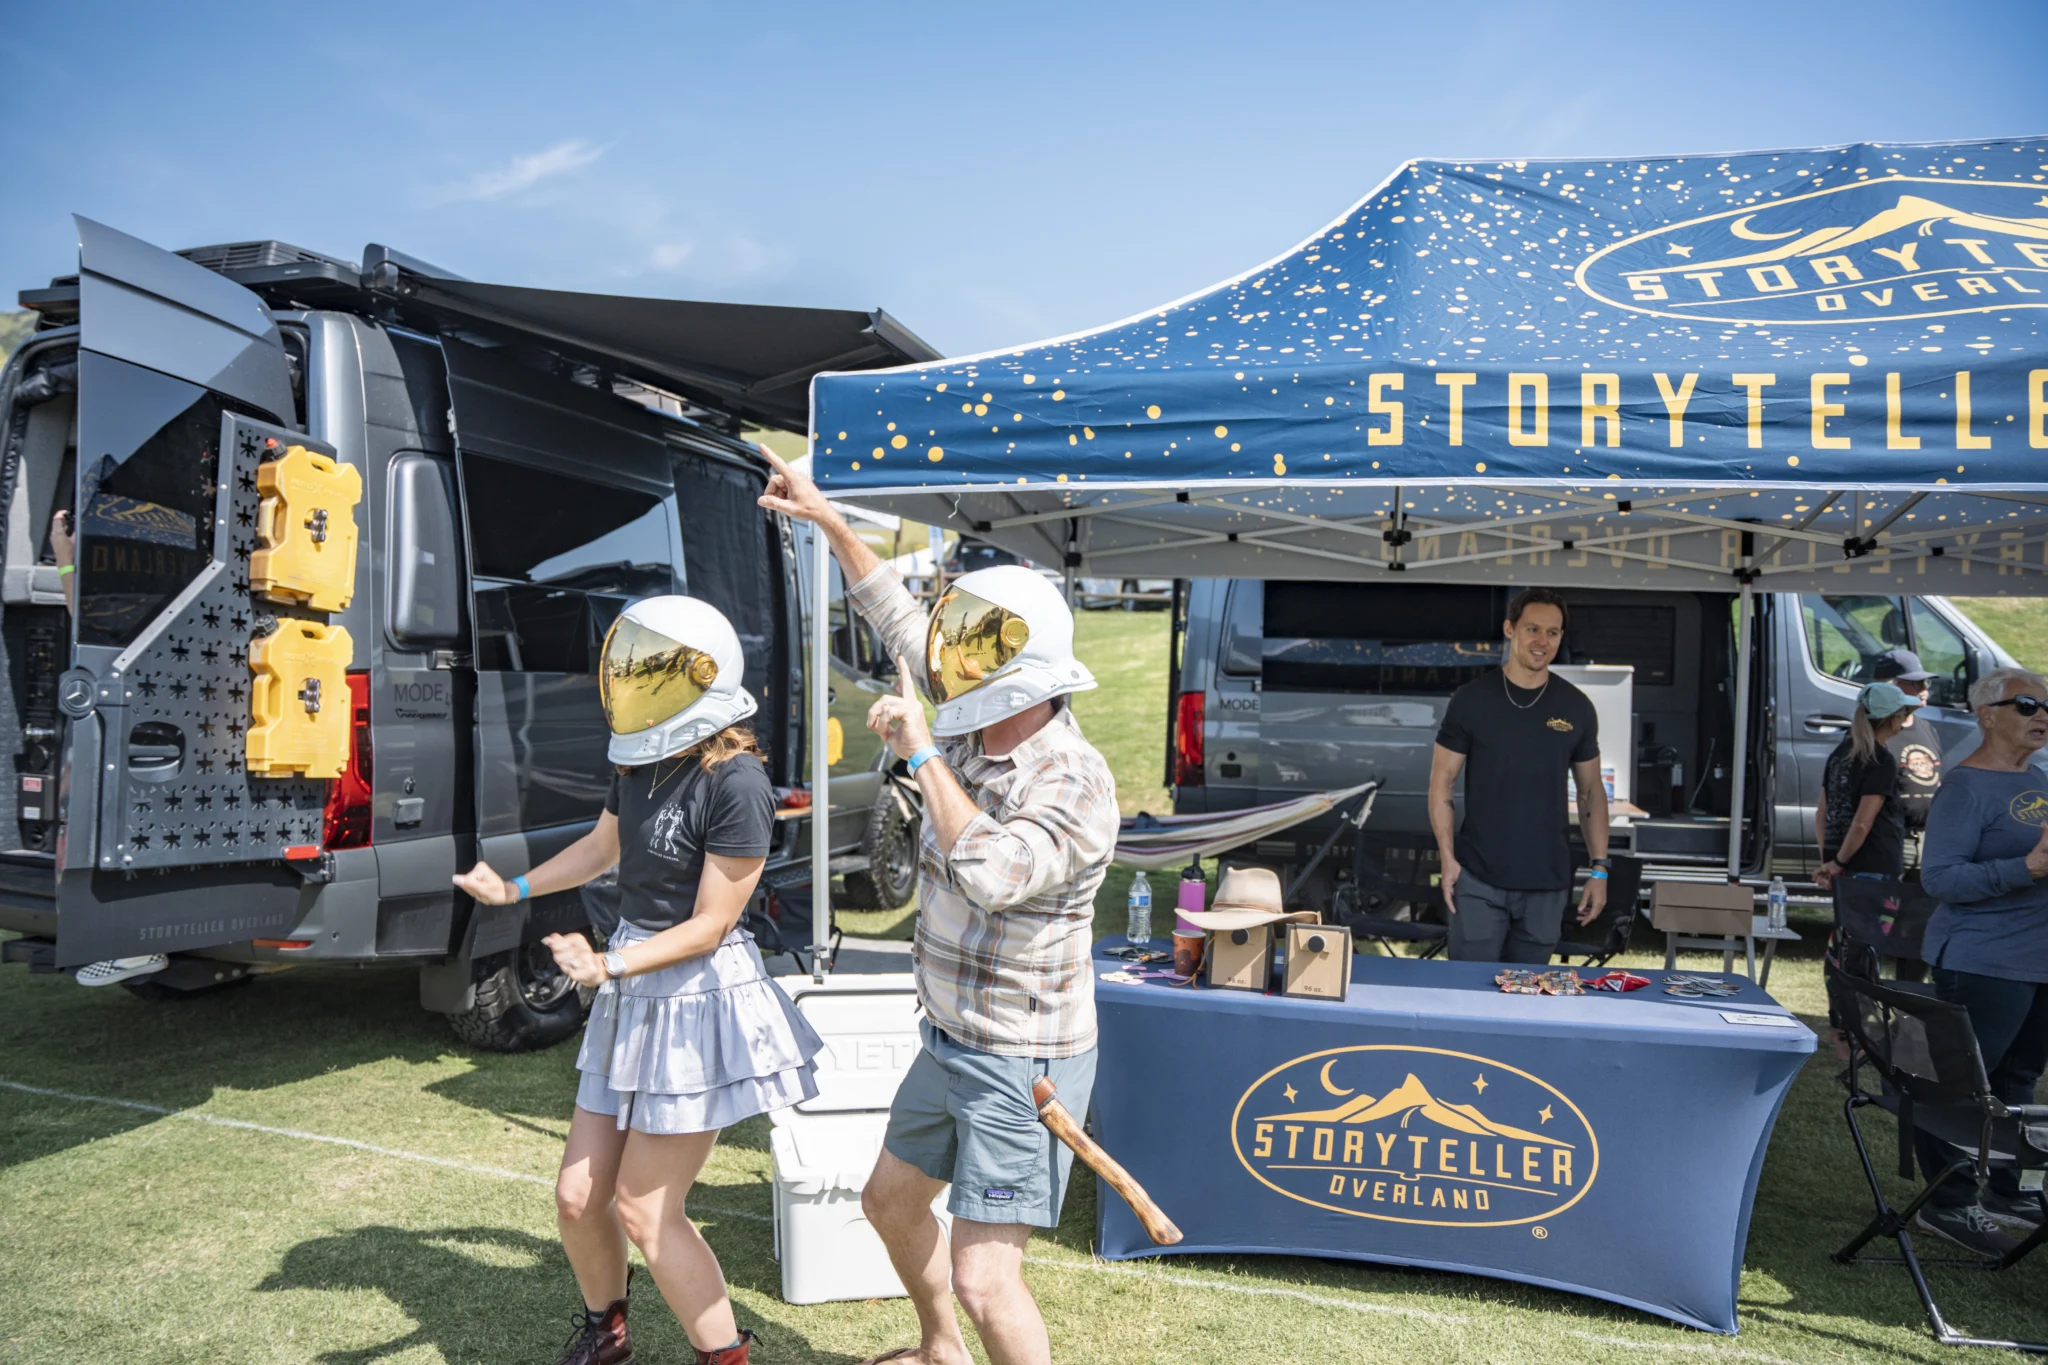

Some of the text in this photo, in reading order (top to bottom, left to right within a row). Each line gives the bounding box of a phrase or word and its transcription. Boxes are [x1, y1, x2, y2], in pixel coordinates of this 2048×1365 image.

[1815, 276, 2041, 312] OVERL
[394, 683, 443, 702] MODE
[1220, 699, 1260, 711] MODE
[139, 913, 284, 941] STORYTELLER OVERLAND
[1253, 1123, 1573, 1187] STORYTELLER
[1329, 1174, 1490, 1211] OVERLAND
